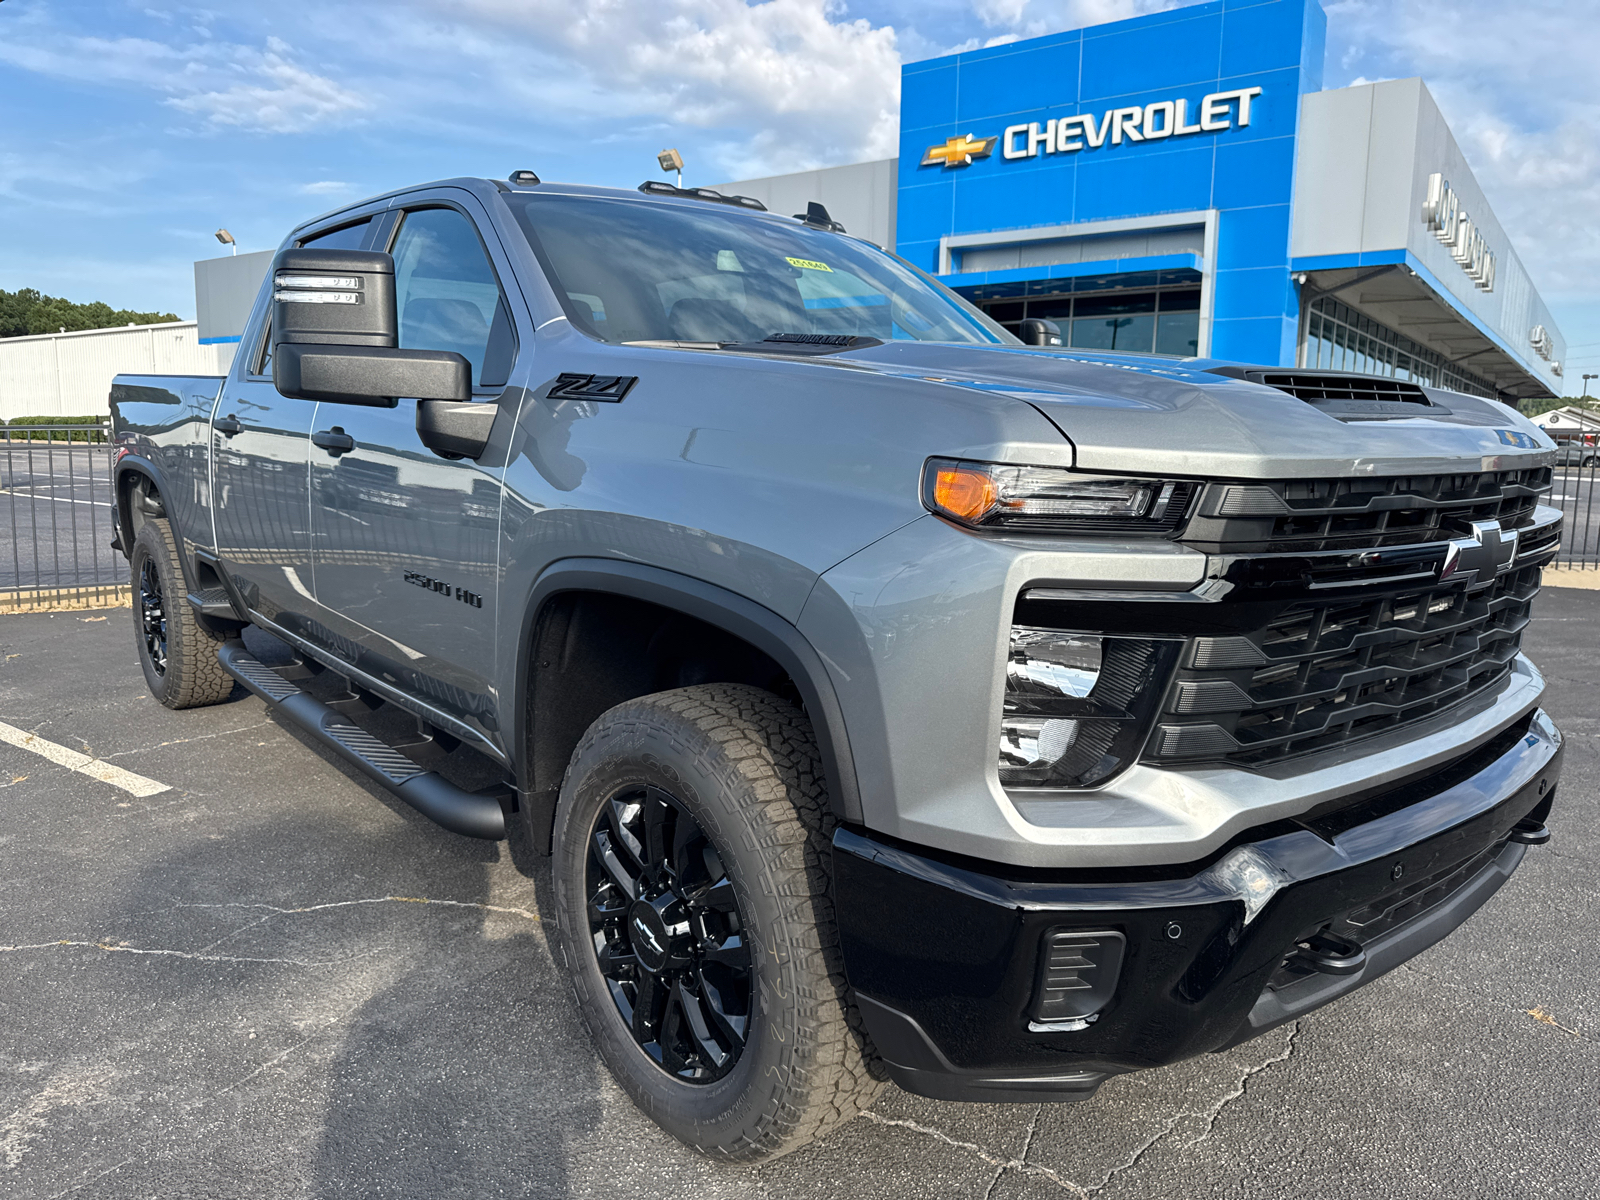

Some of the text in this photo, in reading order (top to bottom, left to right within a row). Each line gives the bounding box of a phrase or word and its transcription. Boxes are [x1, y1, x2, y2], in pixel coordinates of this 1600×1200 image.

[1003, 86, 1262, 160] CHEVROLET
[546, 372, 640, 403] Z71
[403, 569, 483, 609] 2500 HD
[640, 752, 769, 1016] GOODYEAR
